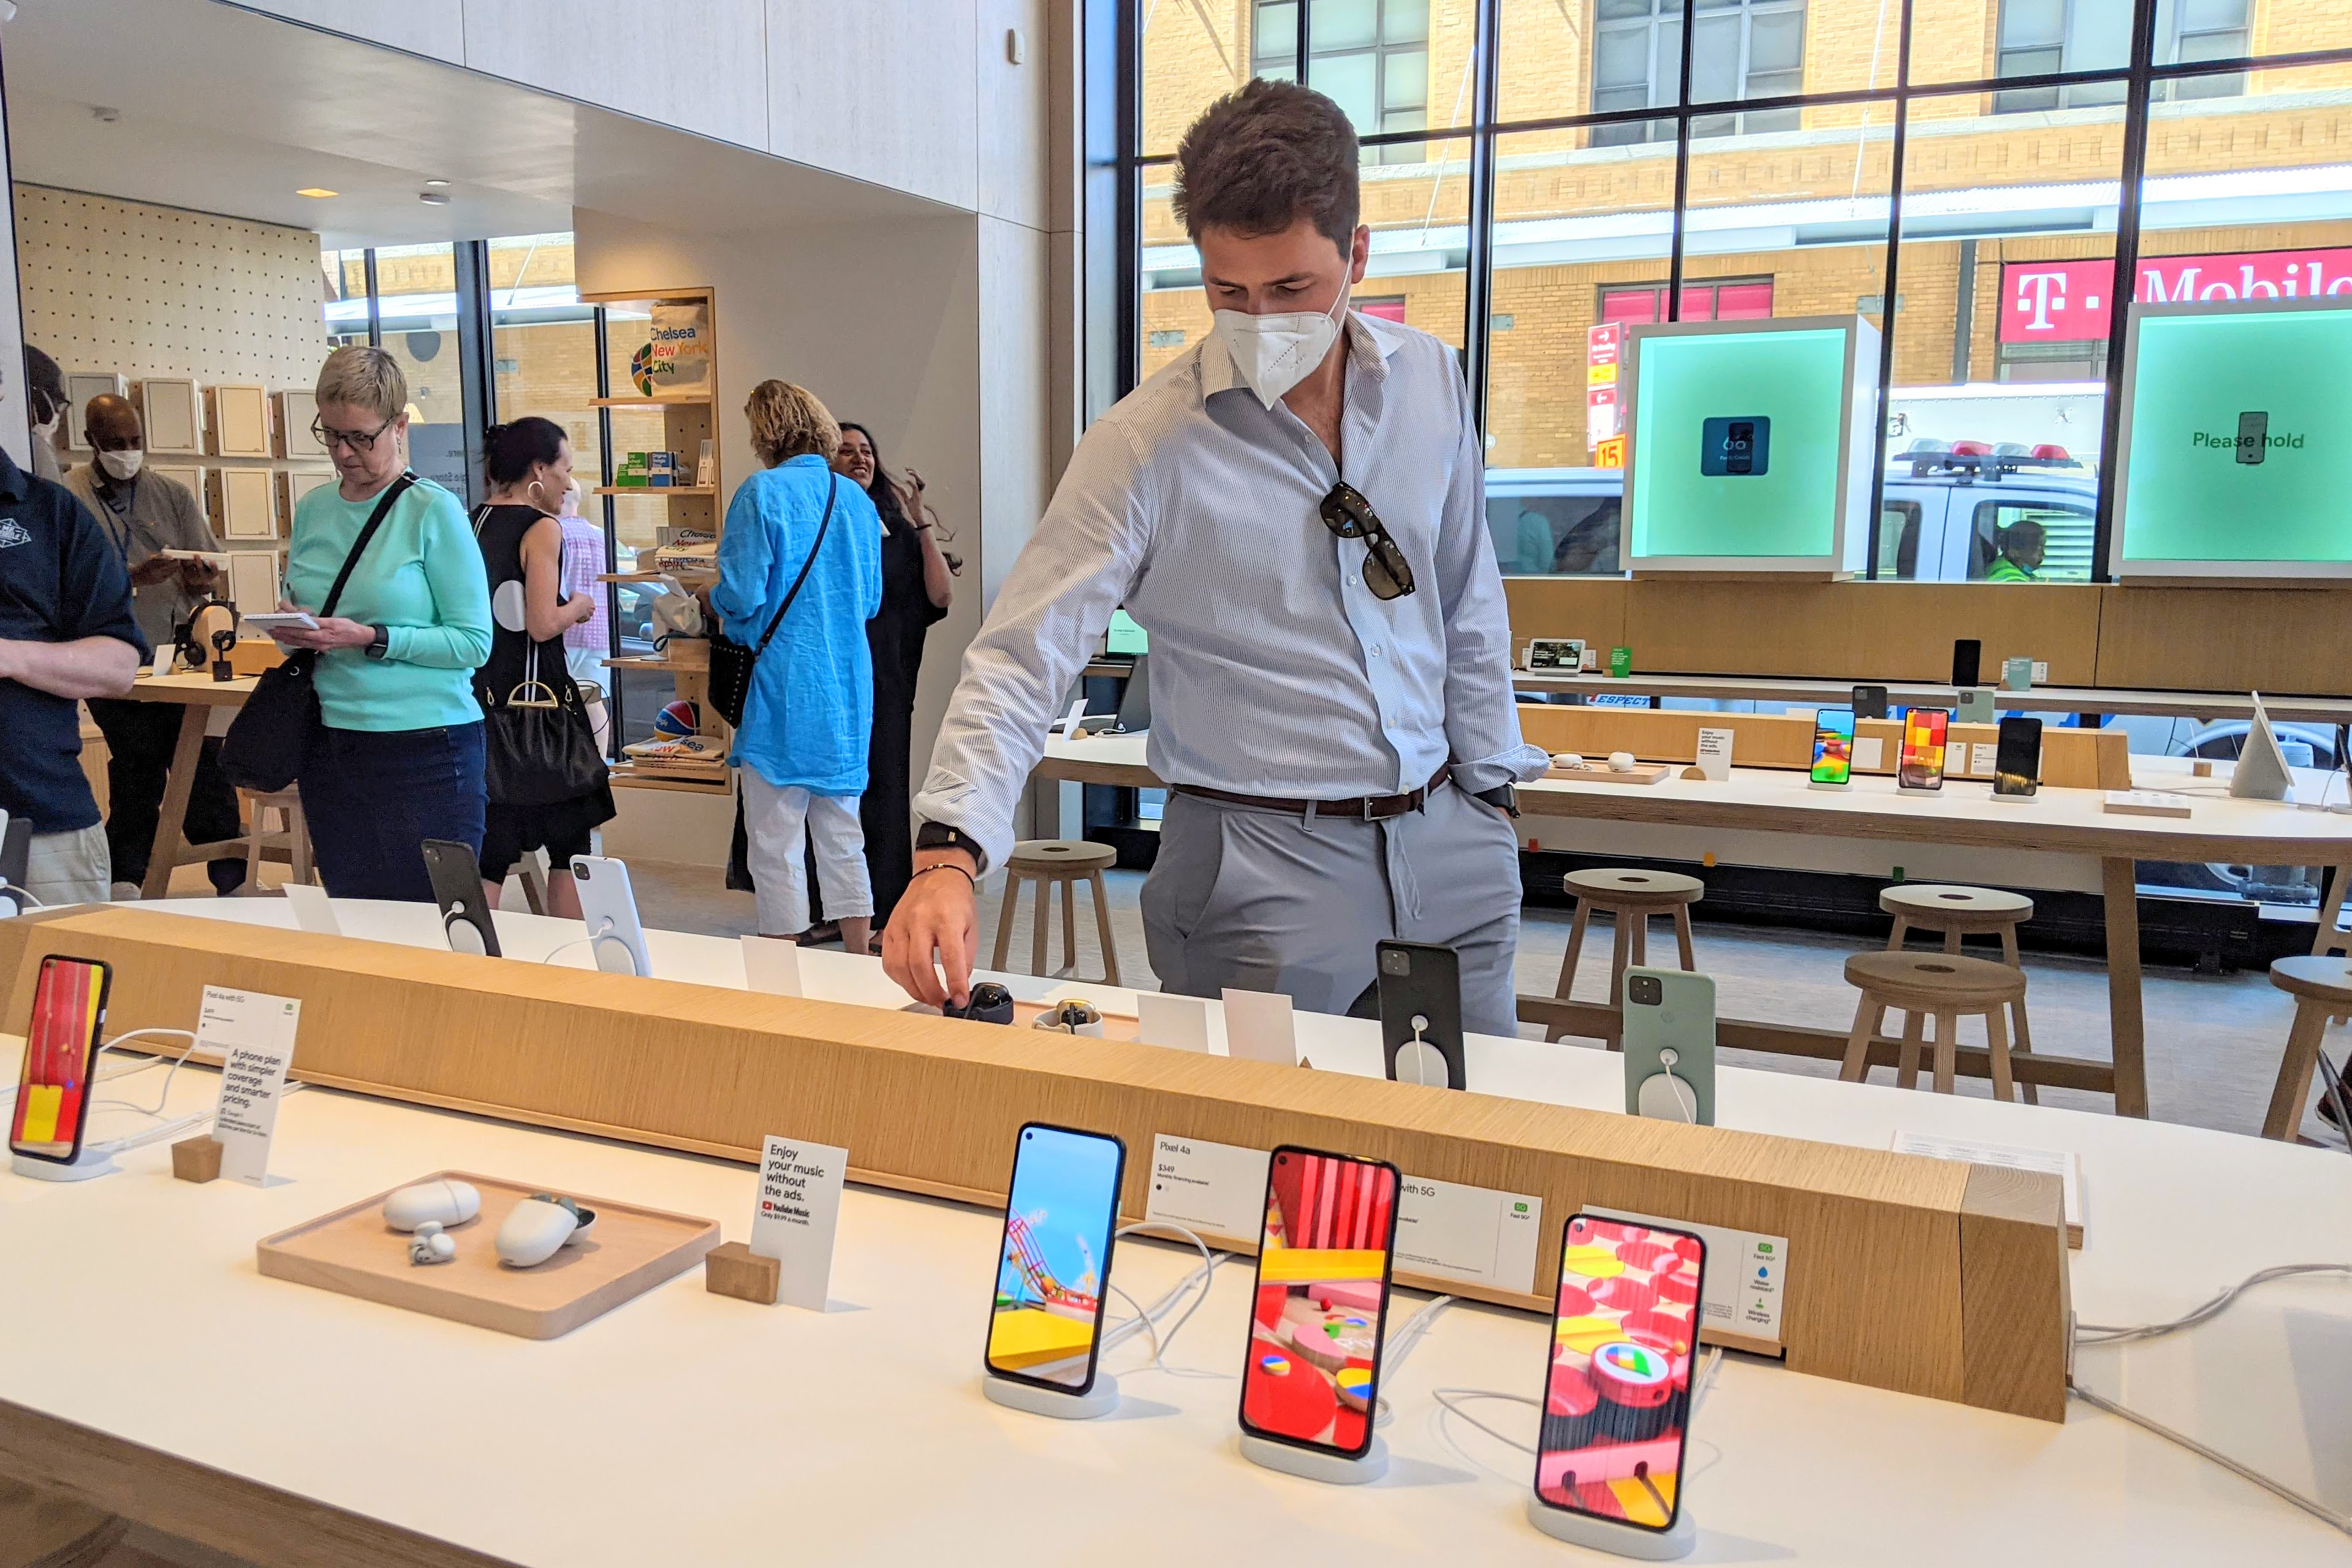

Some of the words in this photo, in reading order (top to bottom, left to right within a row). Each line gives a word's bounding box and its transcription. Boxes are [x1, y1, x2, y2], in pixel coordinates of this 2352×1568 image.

[650, 326, 696, 341] Chelsea
[652, 344, 675, 357] New
[677, 341, 708, 354] York
[653, 360, 674, 374] City
[2193, 432, 2255, 448] Please
[2261, 433, 2304, 449] hold
[1602, 445, 1618, 467] 15
[231, 1048, 238, 1058] A
[239, 1051, 264, 1062] phone
[264, 1056, 281, 1066] plan
[230, 1060, 246, 1070] with
[248, 1064, 276, 1076] simpler
[227, 1073, 262, 1087] coverage
[226, 1084, 240, 1093] and
[241, 1087, 271, 1098] smarter
[770, 1144, 799, 1161] Enjoy
[1160, 1141, 1178, 1152] Pixel
[1180, 1145, 1191, 1154] 4a
[768, 1159, 792, 1170] your
[794, 1164, 824, 1177] music
[1158, 1164, 1175, 1172] $349
[766, 1172, 806, 1187] without
[765, 1184, 781, 1197] the
[784, 1189, 805, 1202] ads.
[1400, 1183, 1418, 1194] with
[1421, 1186, 1435, 1197] 5G
[761, 1211, 773, 1219] Only
[773, 1203, 793, 1214] YouTube
[794, 1206, 810, 1218] Music
[1748, 1309, 1770, 1318] Wireless
